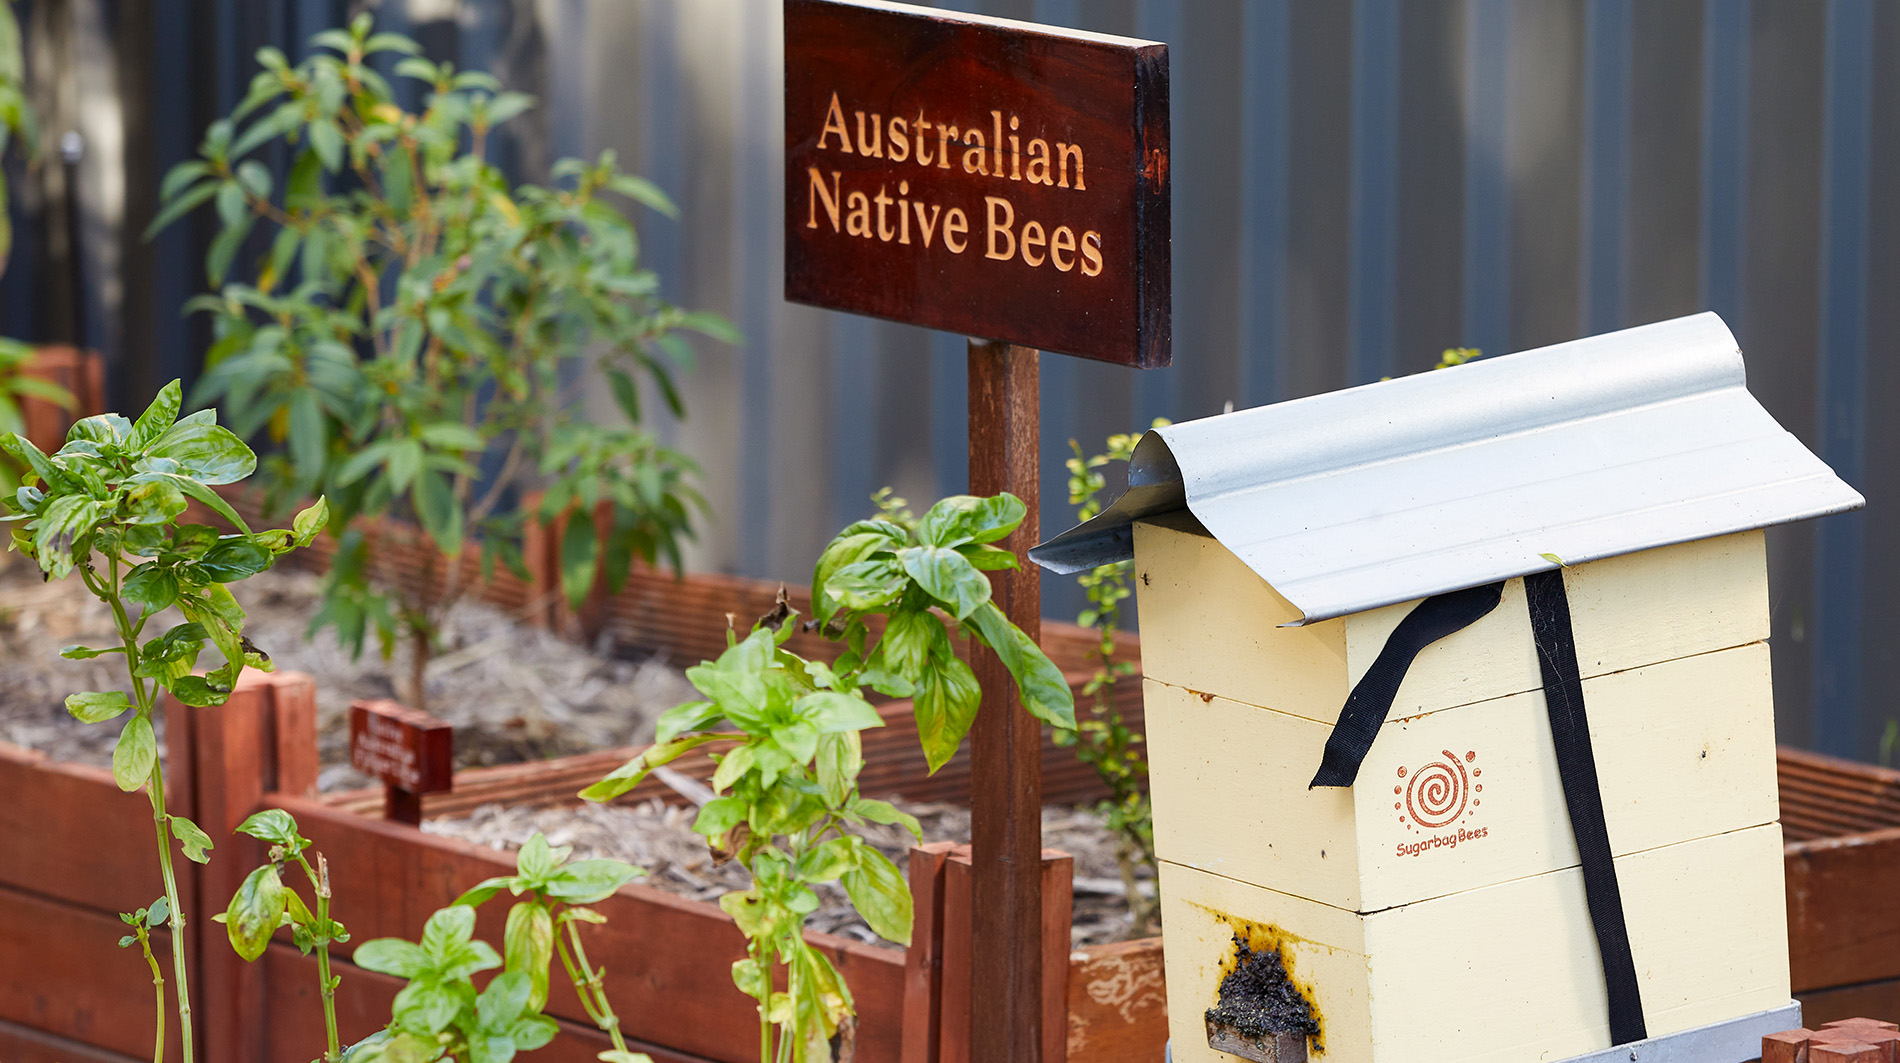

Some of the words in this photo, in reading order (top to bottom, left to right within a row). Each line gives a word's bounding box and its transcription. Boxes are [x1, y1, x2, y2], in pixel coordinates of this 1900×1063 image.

[817, 91, 1086, 191] Australian
[806, 167, 969, 255] Native
[984, 196, 1103, 277] Bees
